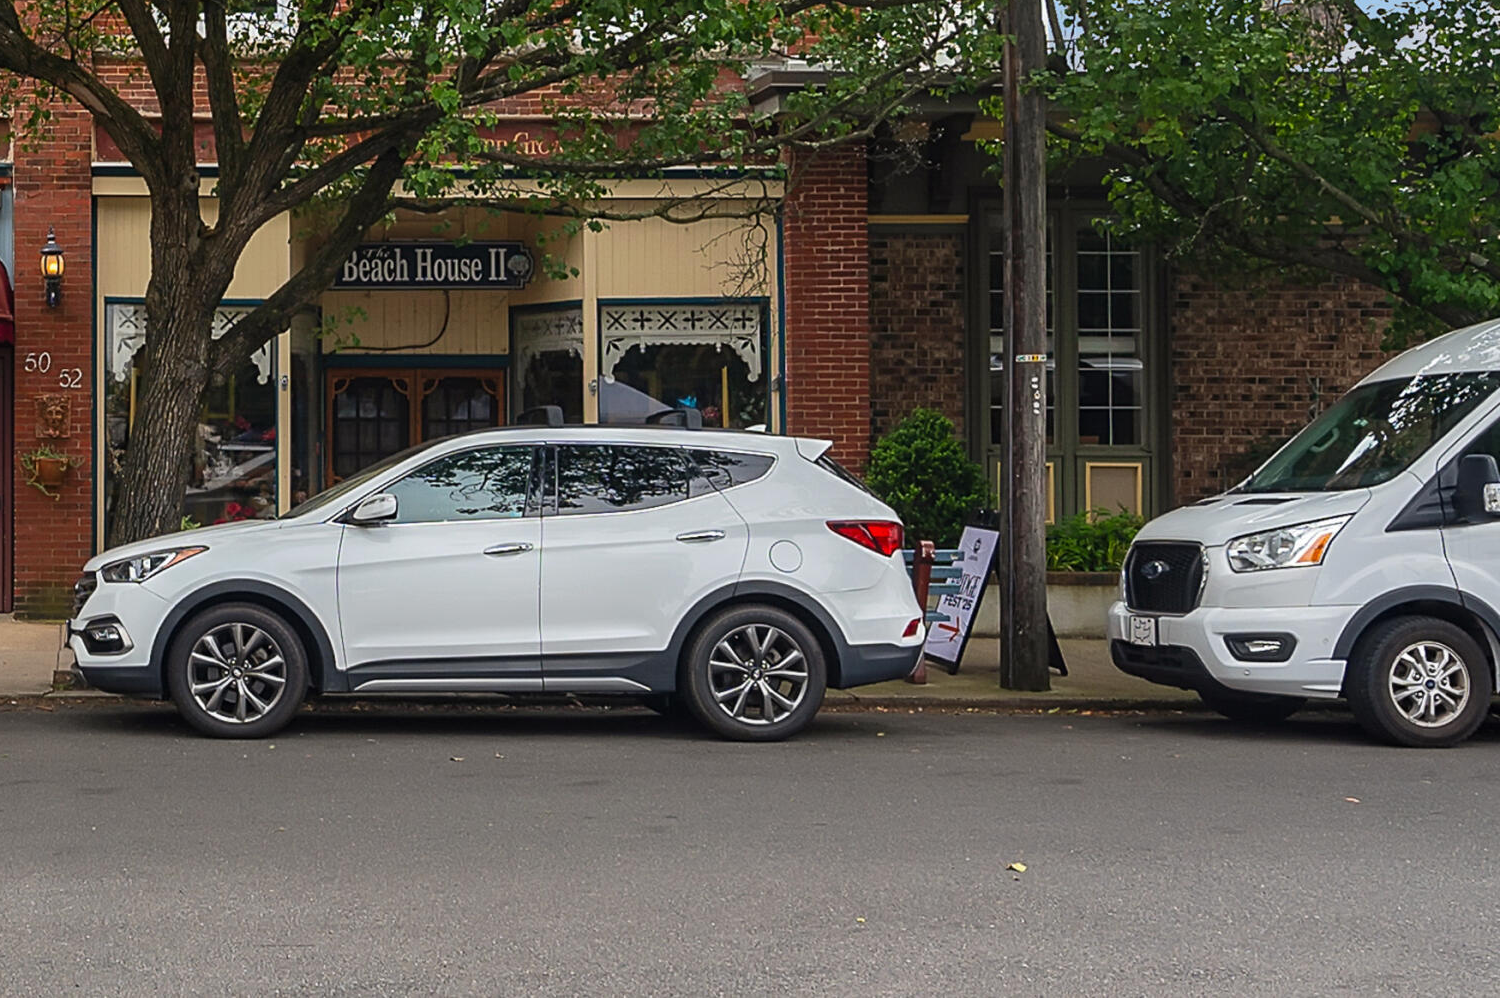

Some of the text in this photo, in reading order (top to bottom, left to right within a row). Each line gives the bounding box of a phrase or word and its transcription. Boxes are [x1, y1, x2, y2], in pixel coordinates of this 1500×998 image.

[362, 245, 390, 258] The
[342, 248, 508, 282] Beach House II
[24, 351, 51, 373] 50
[59, 368, 83, 388] 52
